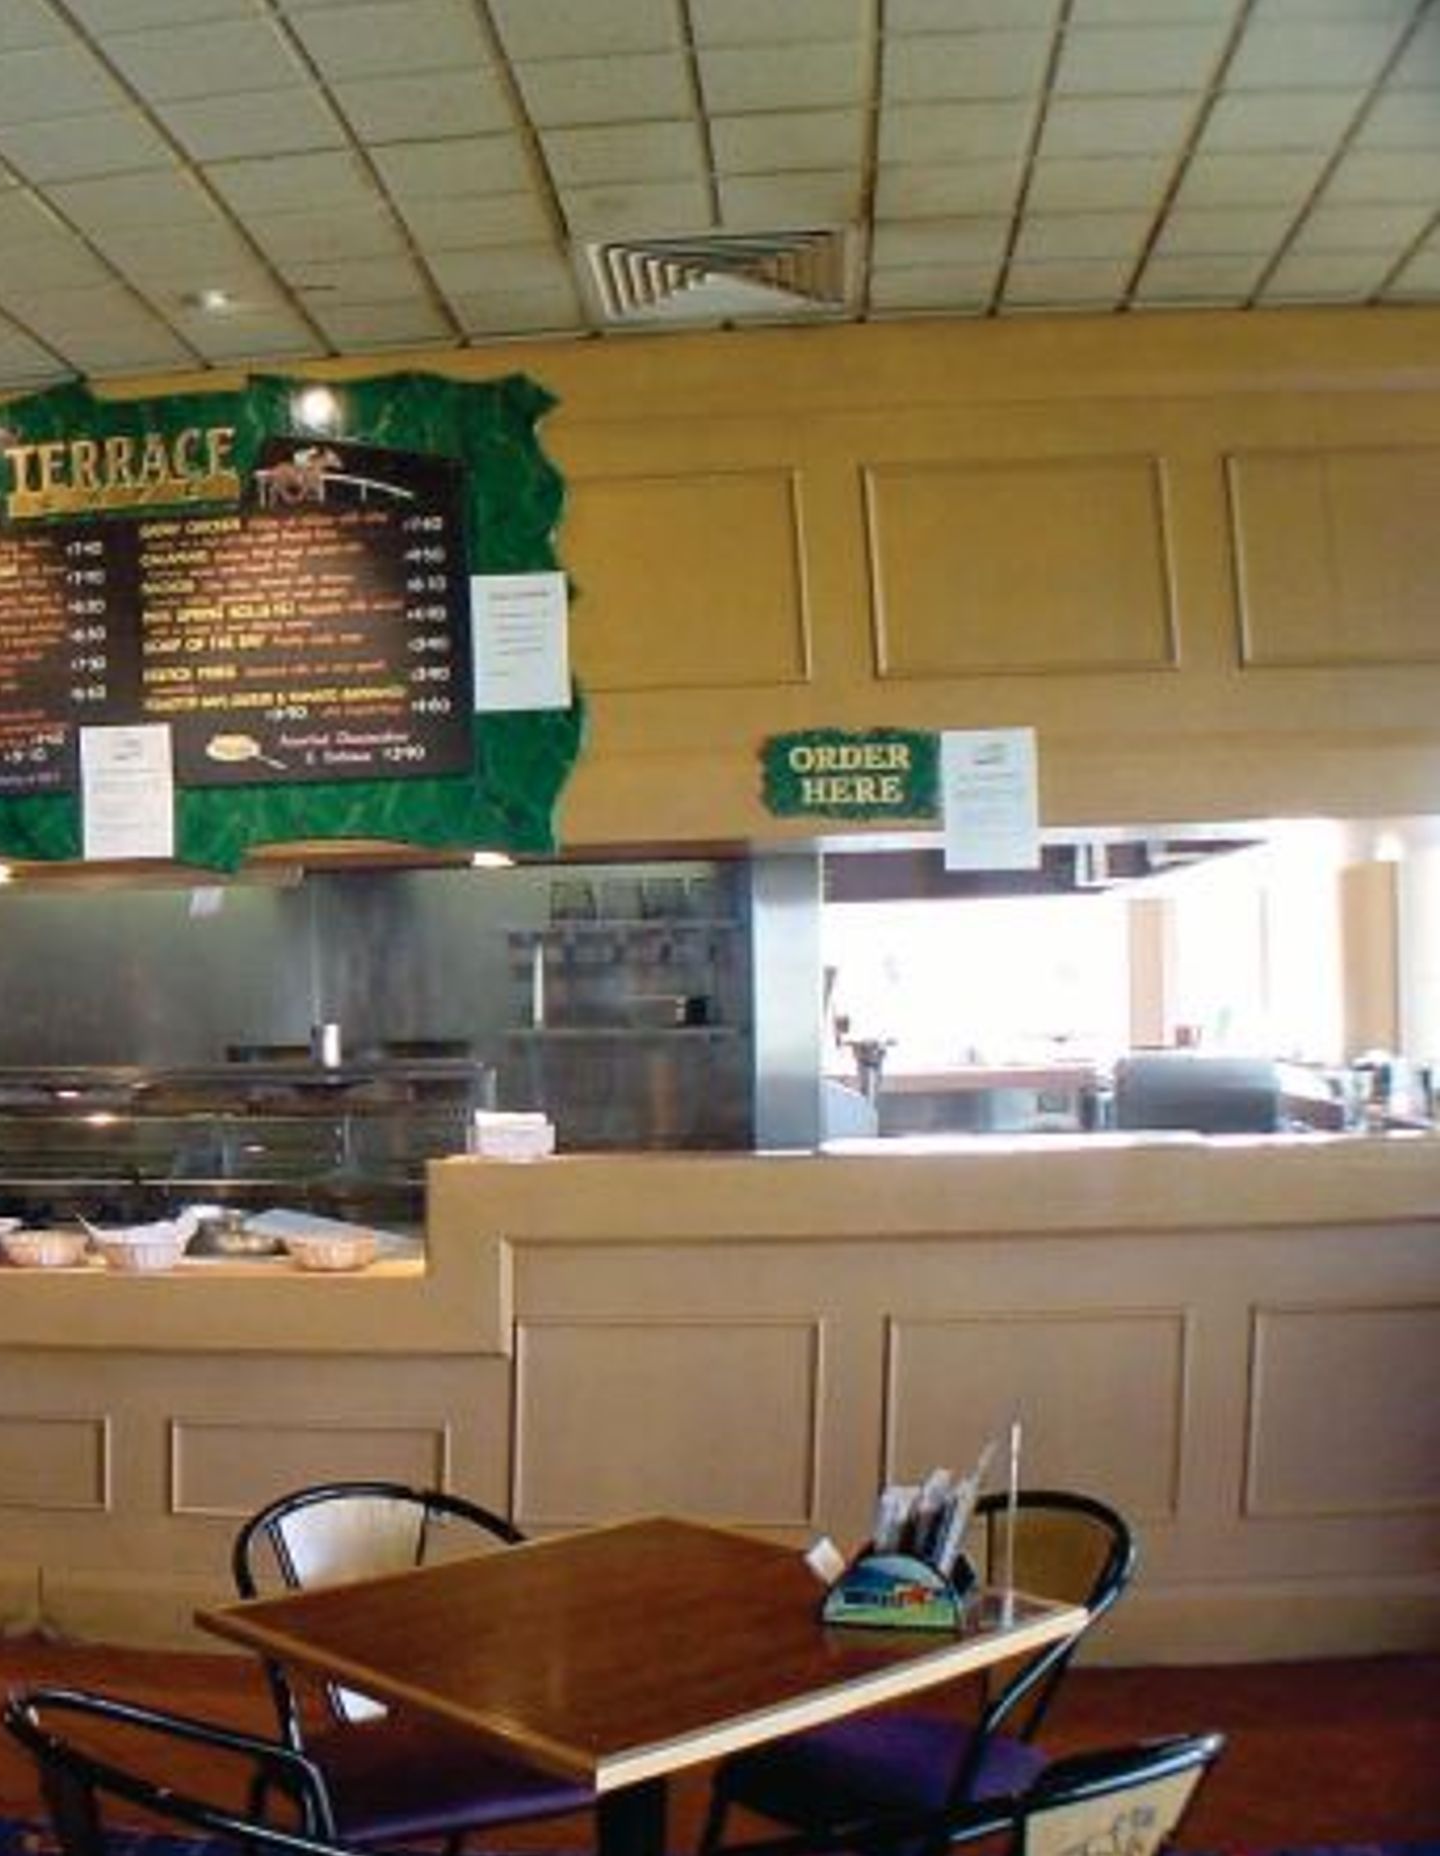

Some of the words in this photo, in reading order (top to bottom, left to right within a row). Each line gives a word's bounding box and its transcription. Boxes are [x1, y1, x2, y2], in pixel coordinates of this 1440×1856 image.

[4, 427, 237, 493] TERRACE
[788, 743, 912, 773] ORDER
[799, 776, 905, 804] HERE
